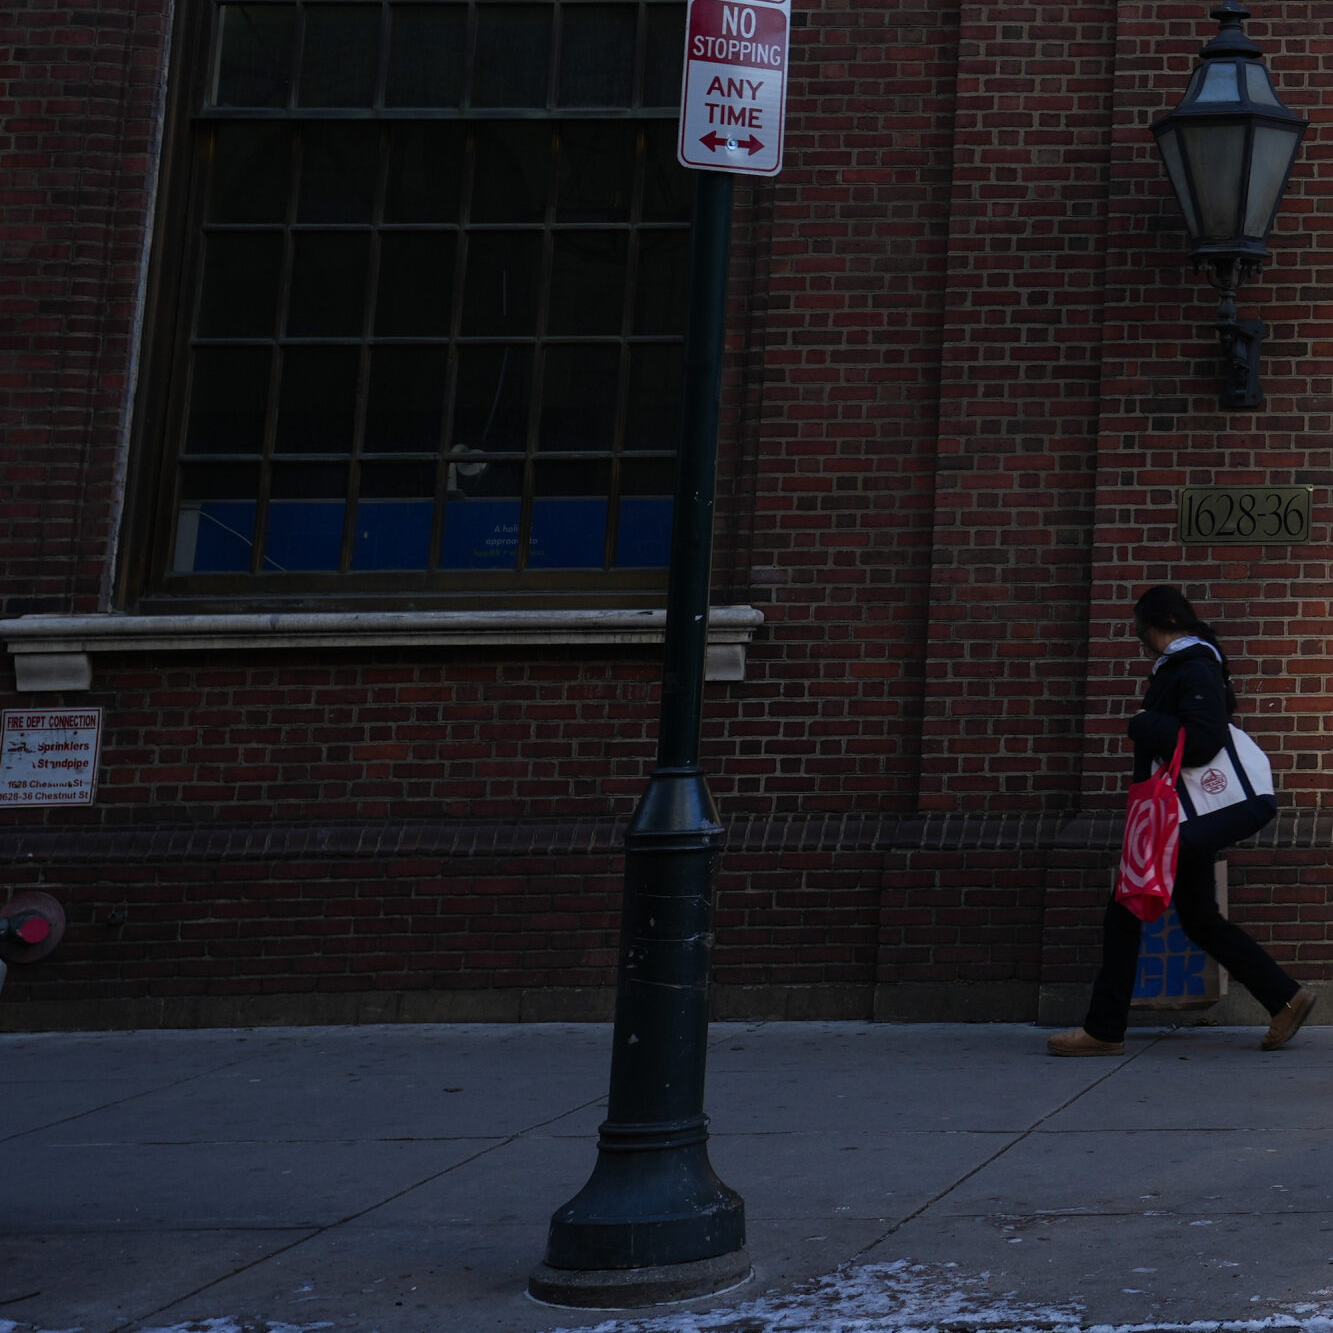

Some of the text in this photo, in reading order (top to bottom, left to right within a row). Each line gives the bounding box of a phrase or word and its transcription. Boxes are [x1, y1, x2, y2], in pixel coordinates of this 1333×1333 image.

[721, 5, 757, 39] NO
[692, 35, 781, 66] STOPPING
[706, 76, 764, 101] ANY
[705, 102, 762, 129] TIME
[1186, 493, 1304, 537] 1628-36
[486, 537, 523, 547] approa
[7, 714, 96, 728] FIRE DEPT CONNECTION
[37, 741, 90, 753] Sprinklers
[73, 778, 83, 787] St
[35, 791, 76, 800] Chestnut
[79, 790, 88, 799] St
